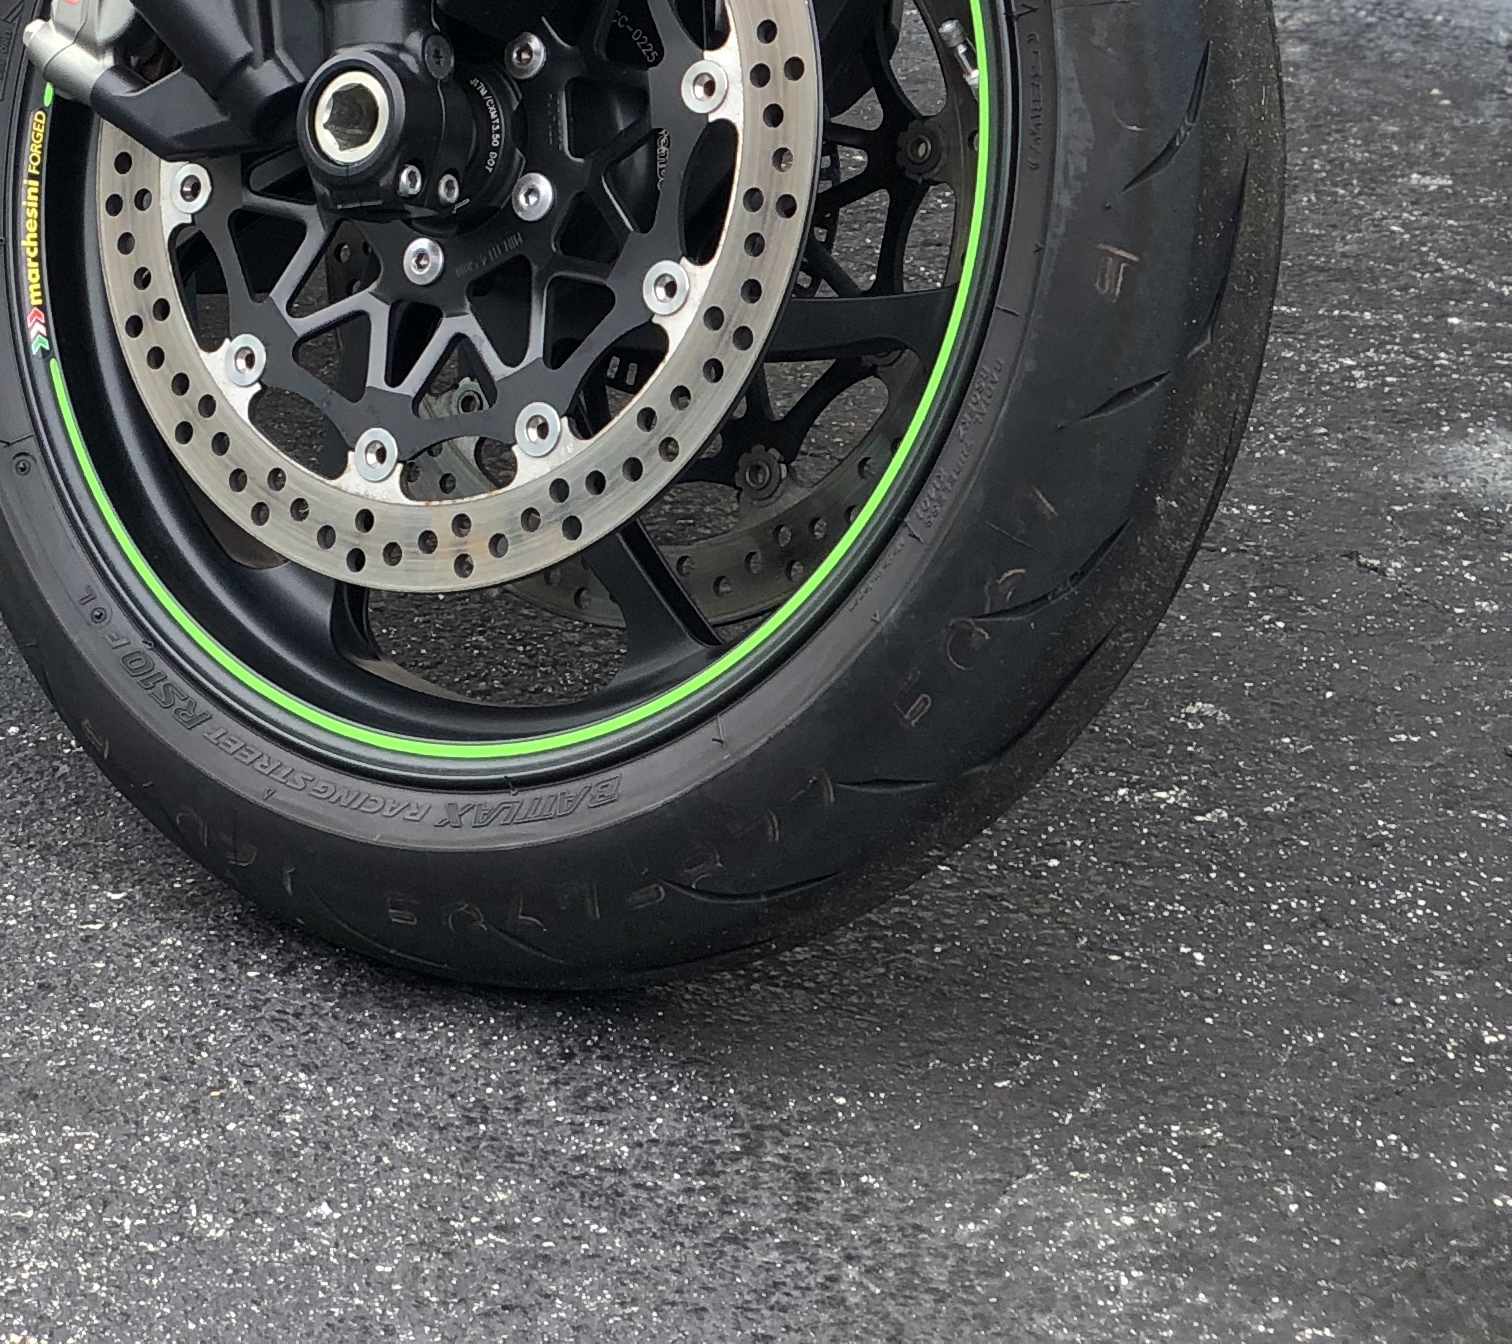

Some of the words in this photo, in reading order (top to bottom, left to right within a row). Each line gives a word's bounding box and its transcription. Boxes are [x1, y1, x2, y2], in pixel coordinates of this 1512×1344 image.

[27, 110, 47, 176] FORGED
[484, 150, 498, 174] DOT
[21, 179, 43, 306] marchesini
[120, 650, 213, 731] RS10
[202, 726, 315, 792] STREET
[309, 784, 432, 822] RACING
[434, 773, 624, 829] BATTLAX
